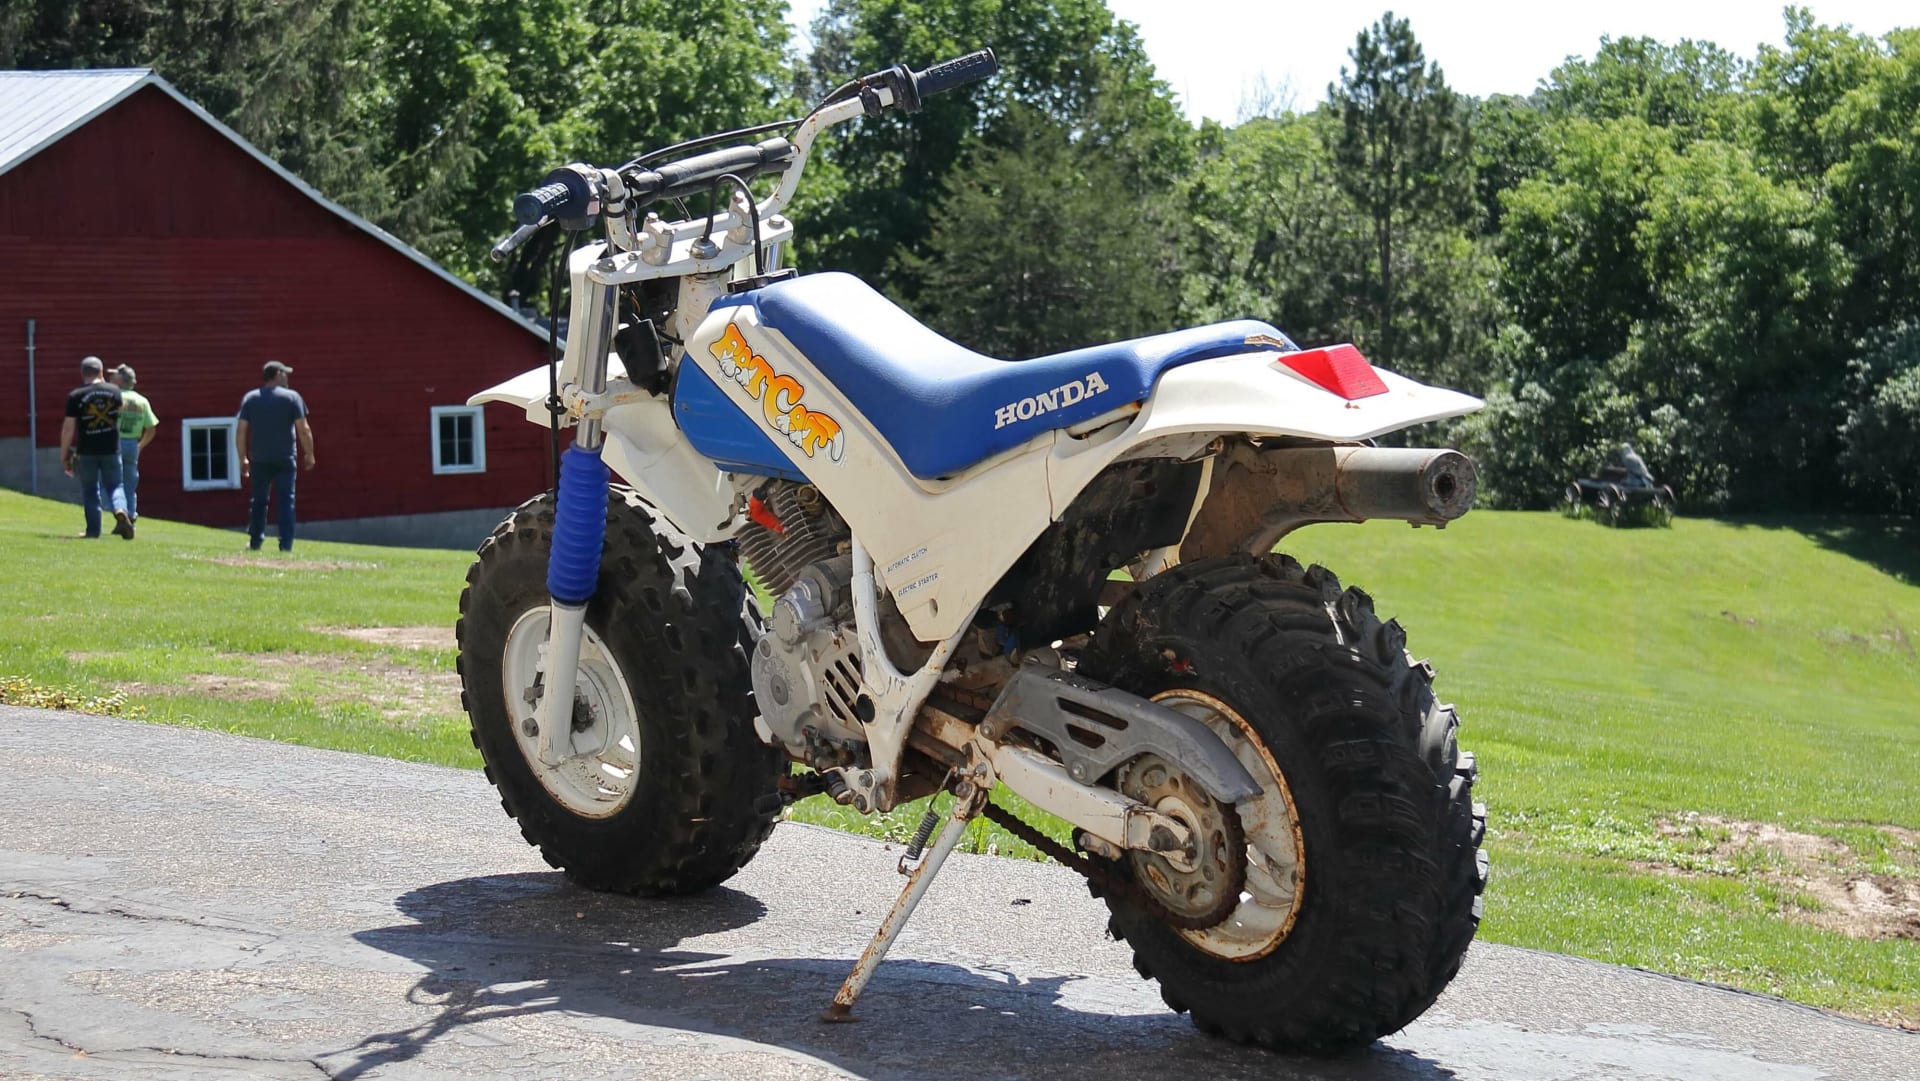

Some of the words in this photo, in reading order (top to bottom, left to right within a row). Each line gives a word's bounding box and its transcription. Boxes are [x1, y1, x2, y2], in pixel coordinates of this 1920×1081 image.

[994, 371, 1110, 430] HONDA
[887, 555, 910, 573] AUTOMATIC
[911, 546, 928, 560] CLUTCH
[898, 582, 917, 597] ELECTRIC
[918, 572, 938, 588] STARTER
